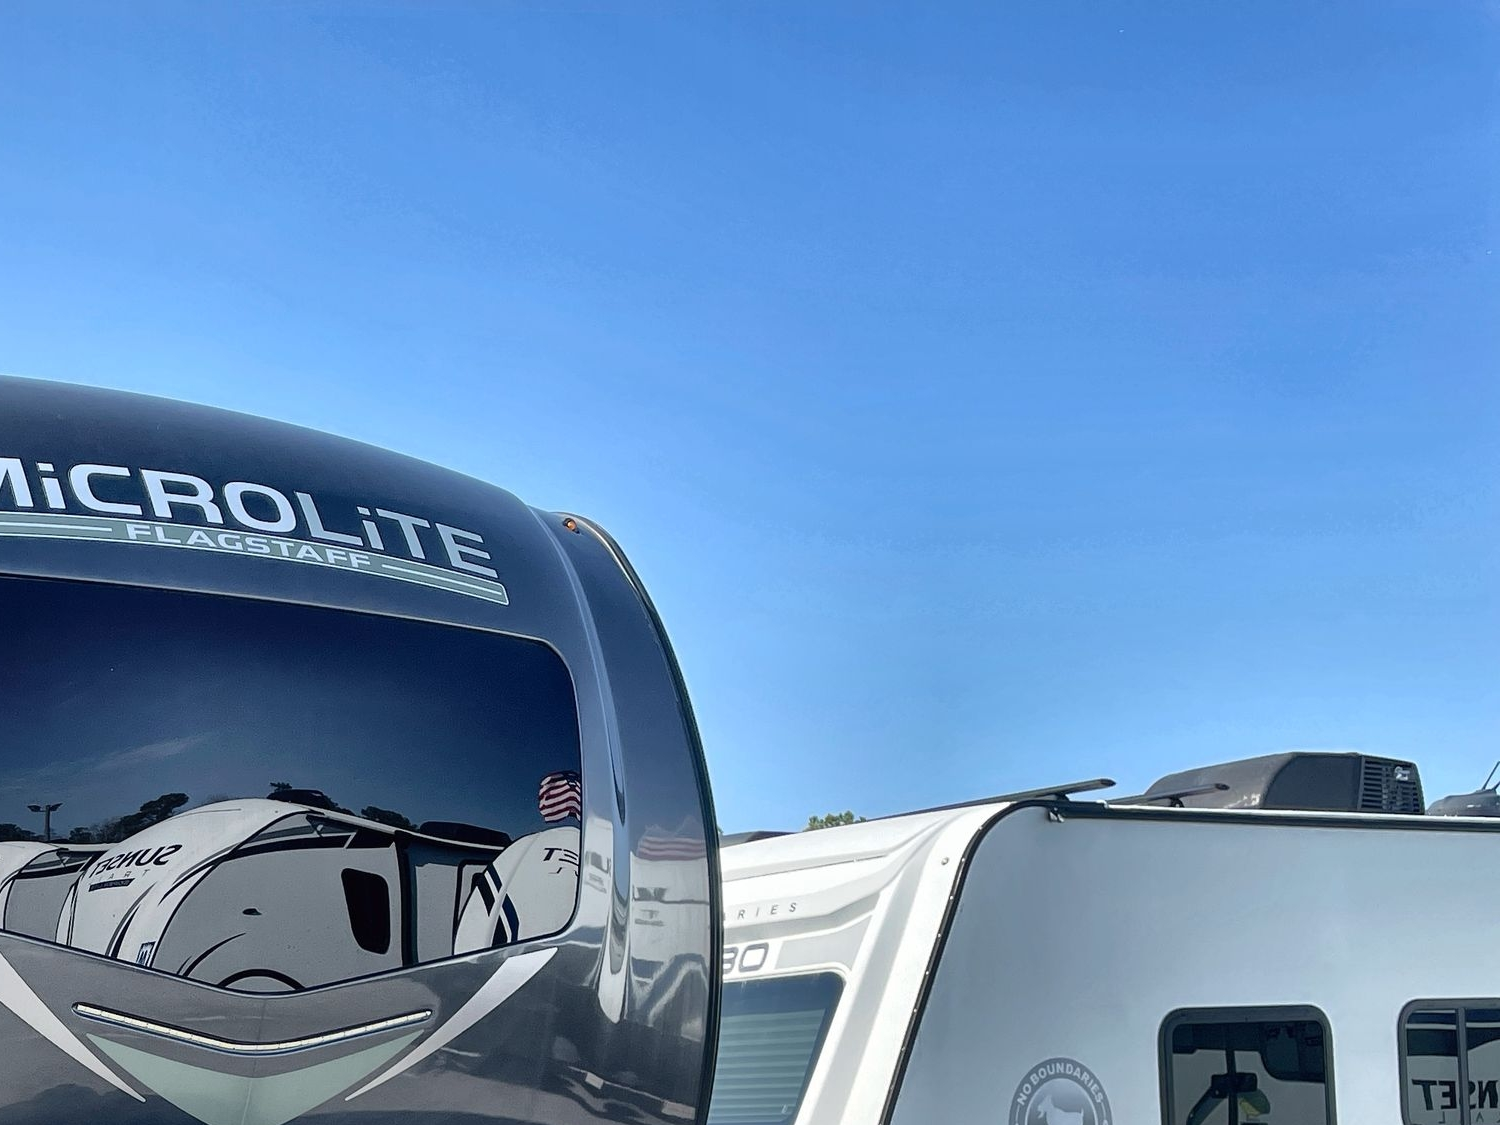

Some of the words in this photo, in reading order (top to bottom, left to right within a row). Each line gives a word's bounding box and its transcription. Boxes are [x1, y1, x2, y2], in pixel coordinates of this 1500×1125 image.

[125, 522, 372, 569] FLAGSTAFF
[723, 902, 798, 920] RIES
[1017, 1085, 1032, 1106] NO
[1030, 1062, 1104, 1104] BOUNDARIES
